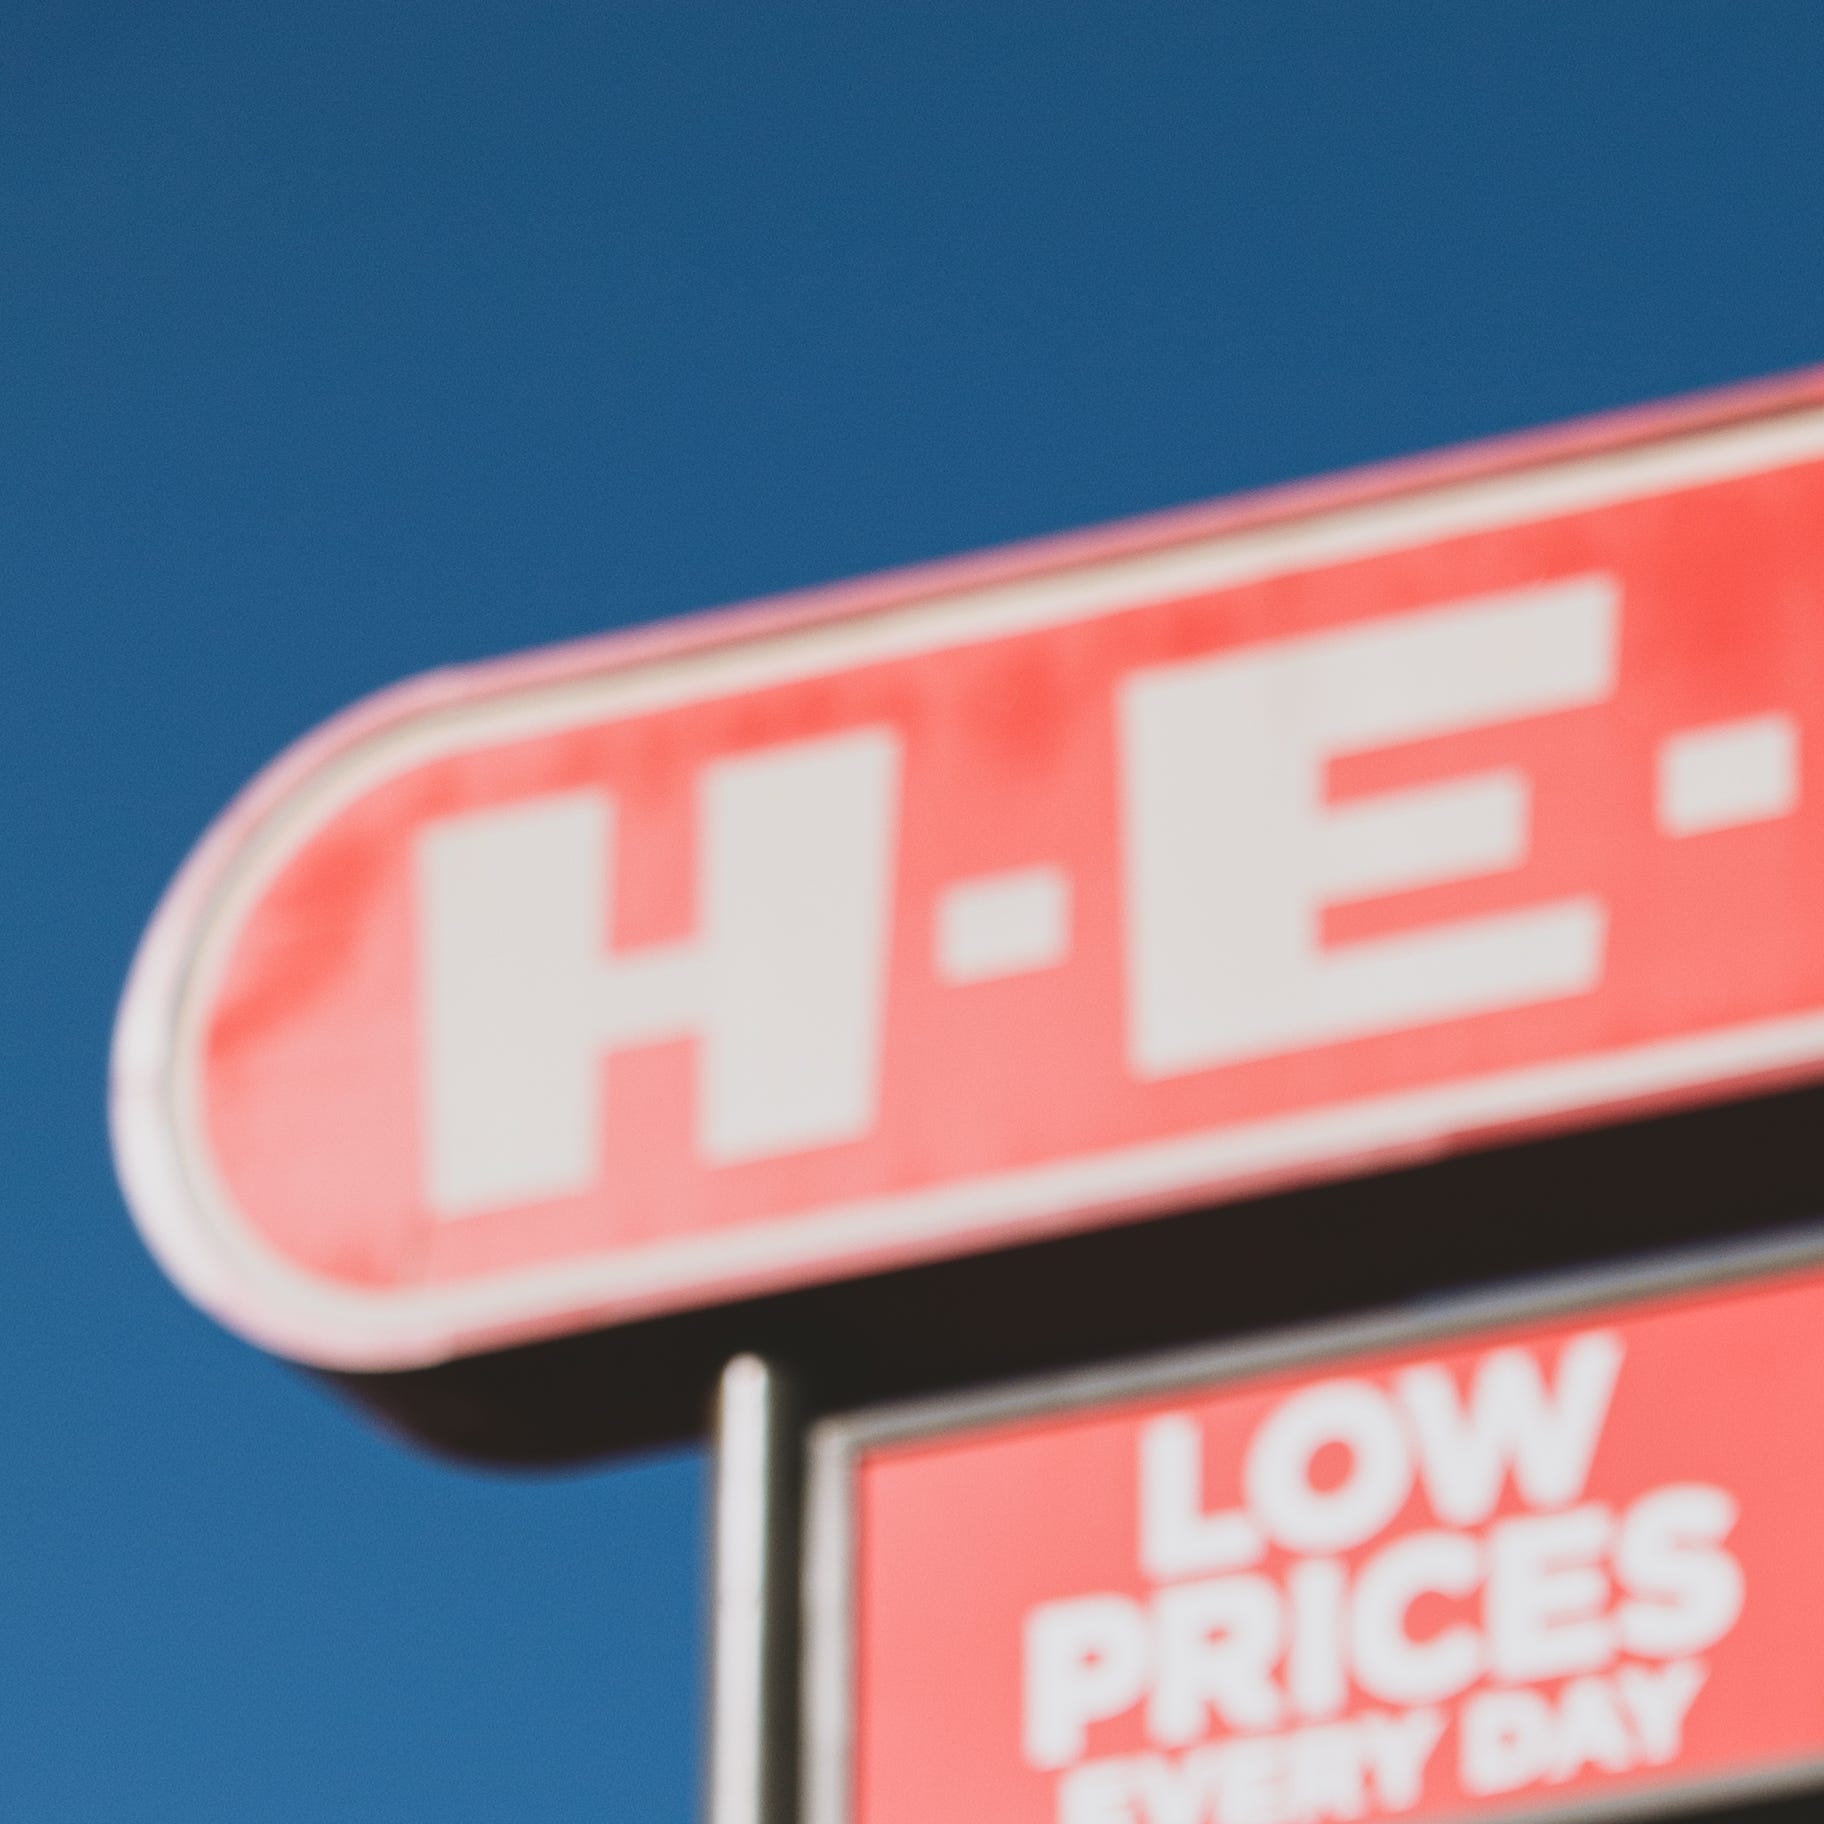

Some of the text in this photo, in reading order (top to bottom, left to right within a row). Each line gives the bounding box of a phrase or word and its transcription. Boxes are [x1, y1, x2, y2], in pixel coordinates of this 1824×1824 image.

[1138, 1328, 1625, 1580] LOW
[1022, 1481, 1747, 1770] PRICES
[1460, 1656, 1708, 1797] DAY
